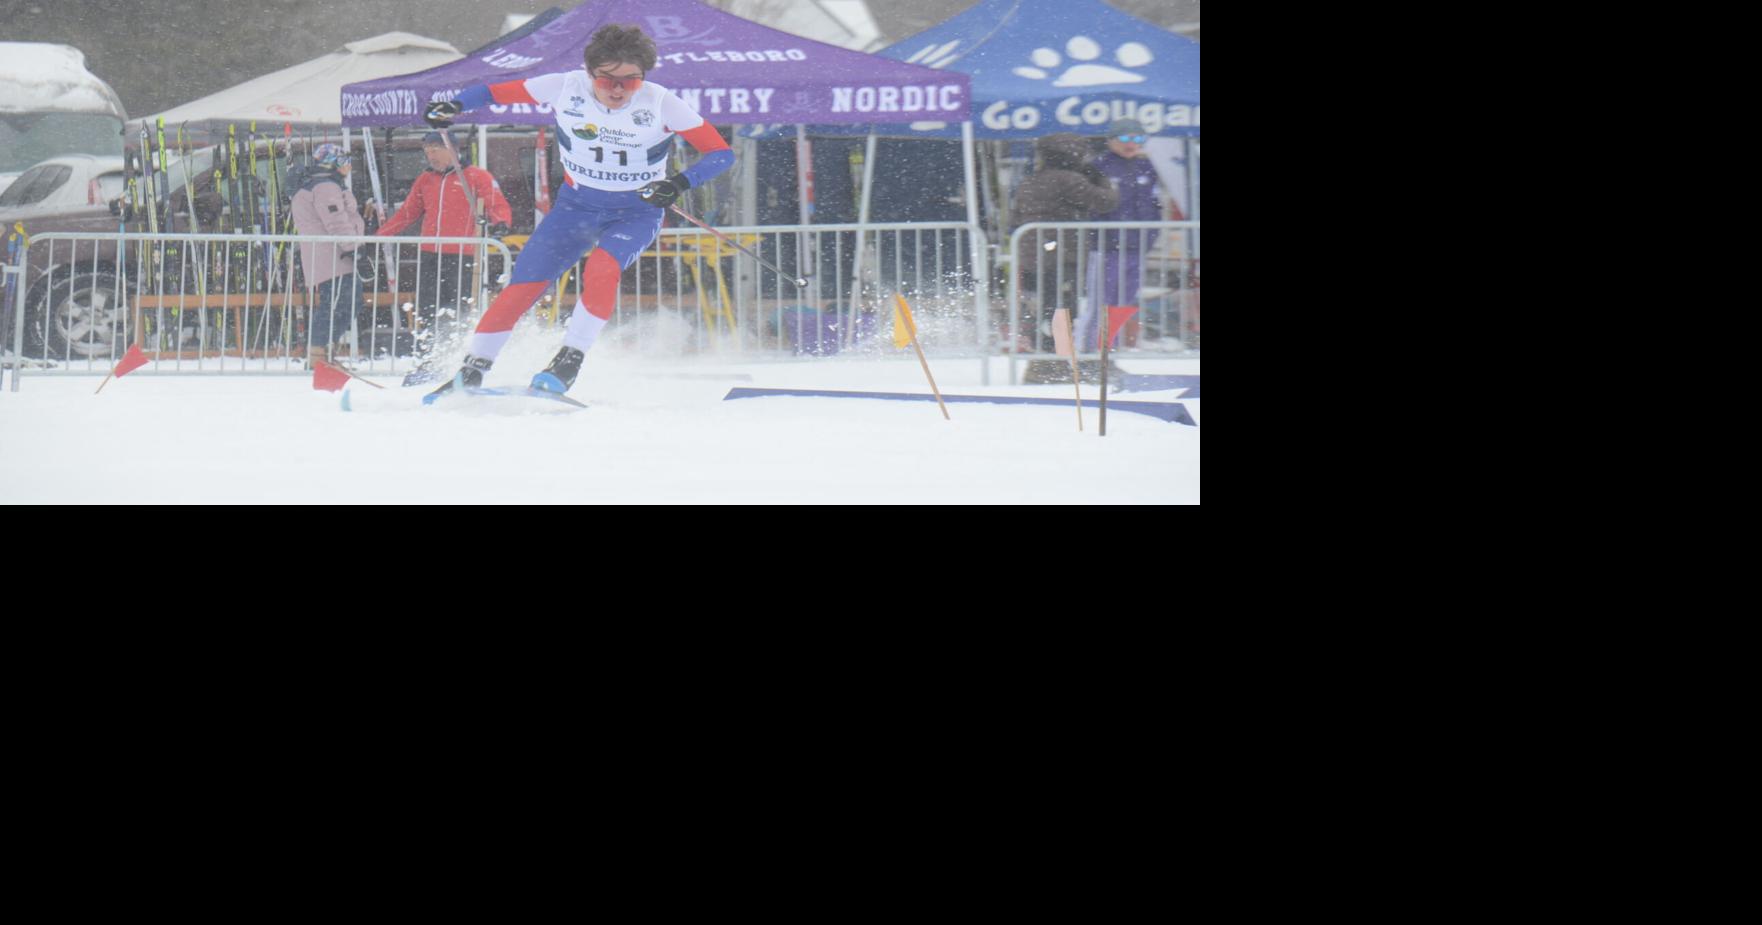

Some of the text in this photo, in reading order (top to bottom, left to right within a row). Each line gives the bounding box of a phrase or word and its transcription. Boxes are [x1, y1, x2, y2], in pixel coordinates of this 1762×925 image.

[655, 49, 807, 68] TLEBORO
[668, 88, 775, 113] NTRY
[831, 85, 962, 113] NORDIC
[981, 100, 1041, 130] Go
[599, 126, 637, 138] Outdoor
[588, 146, 628, 167] 11
